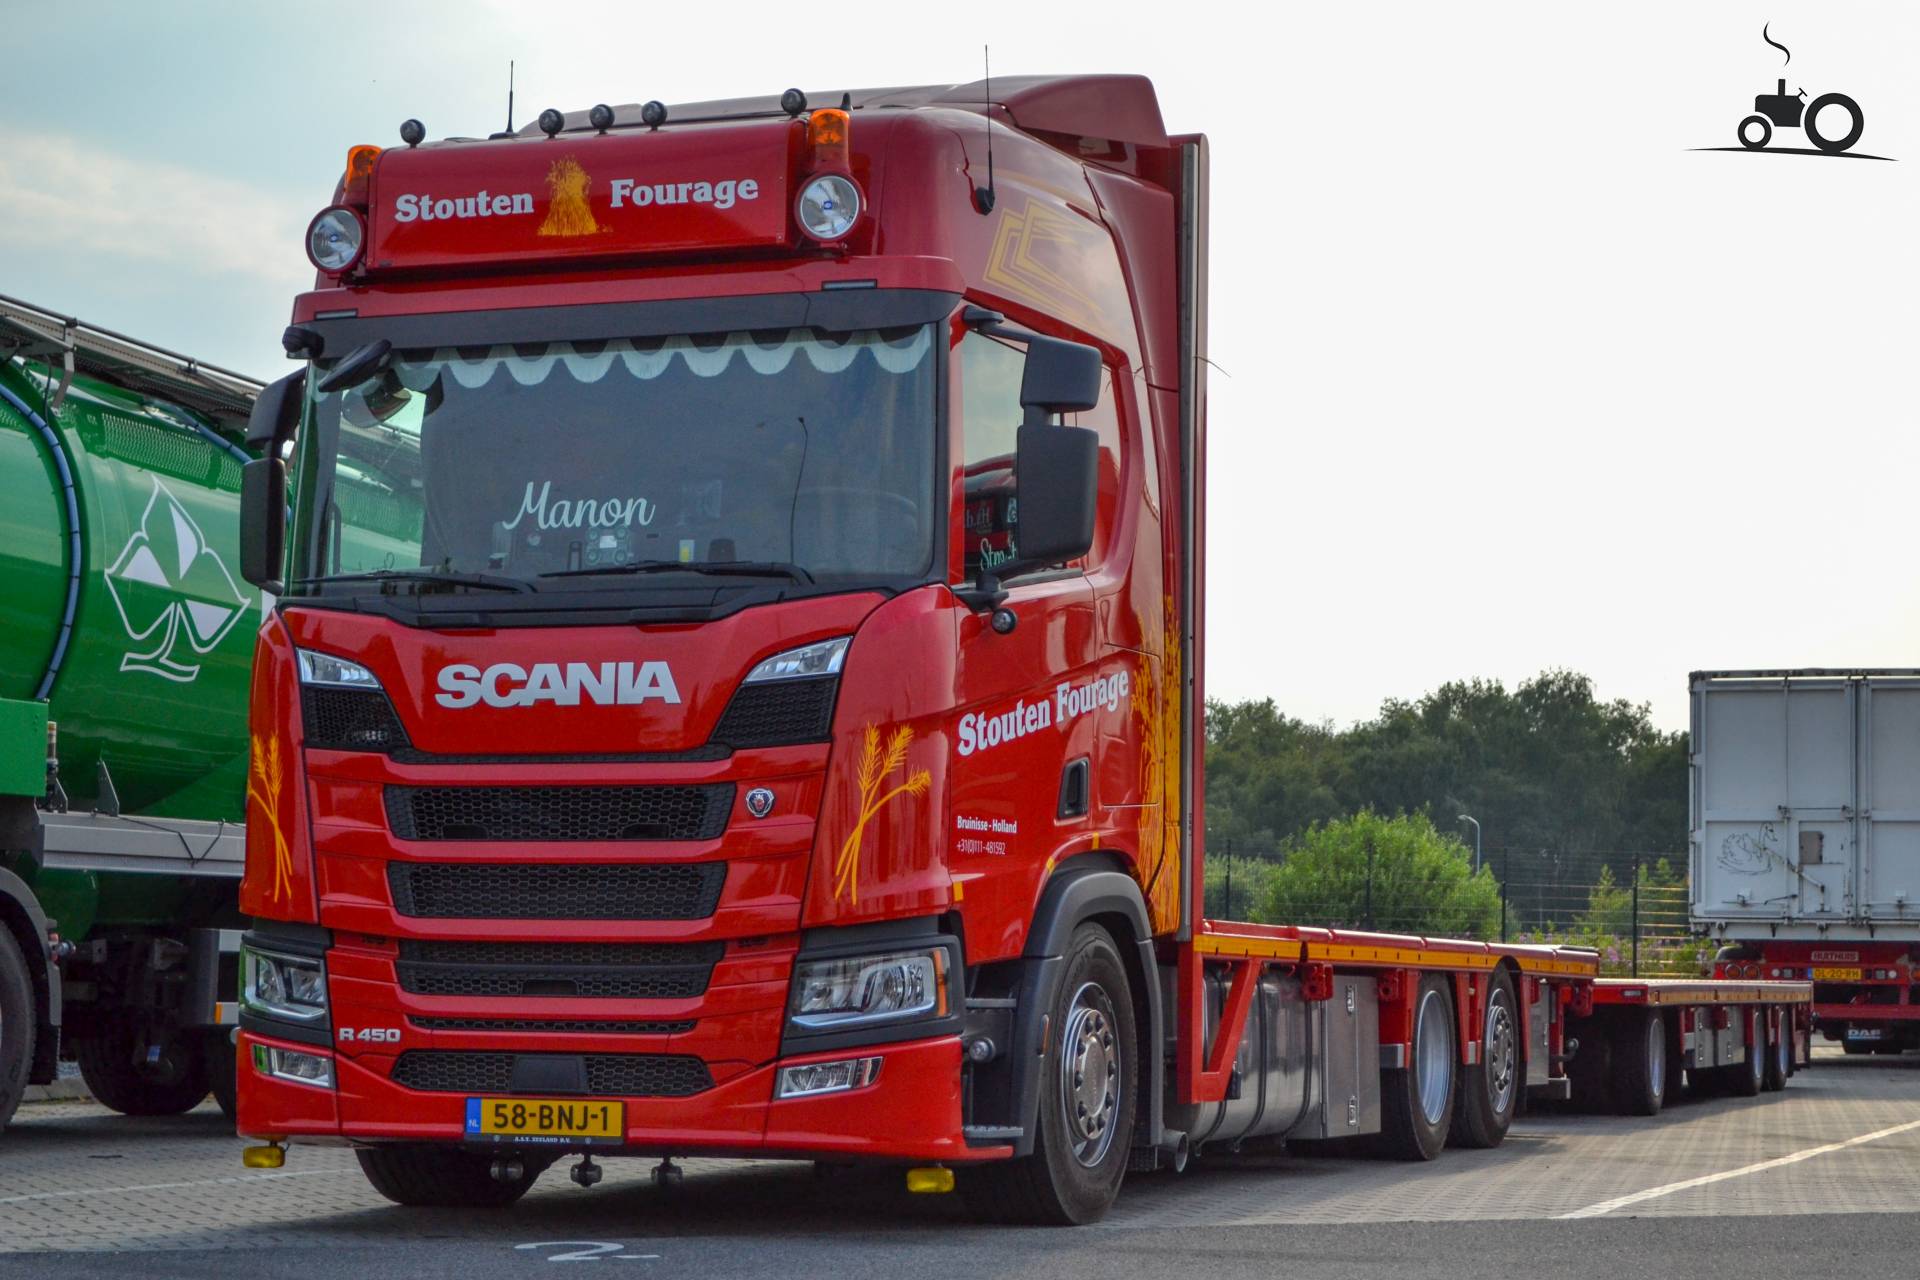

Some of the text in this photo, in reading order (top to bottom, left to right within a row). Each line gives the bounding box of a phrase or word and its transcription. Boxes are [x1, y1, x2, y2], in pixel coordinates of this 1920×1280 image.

[394, 178, 759, 223] Stouten Fourage
[502, 480, 656, 530] Manon
[434, 661, 682, 709] SCANIA
[957, 670, 1129, 756] Stouten Fourage
[957, 815, 988, 831] Bruinisse
[992, 818, 1017, 833] Holland
[339, 1027, 401, 1042] R 450
[469, 1103, 609, 1131] NL 58-BNJ-1
